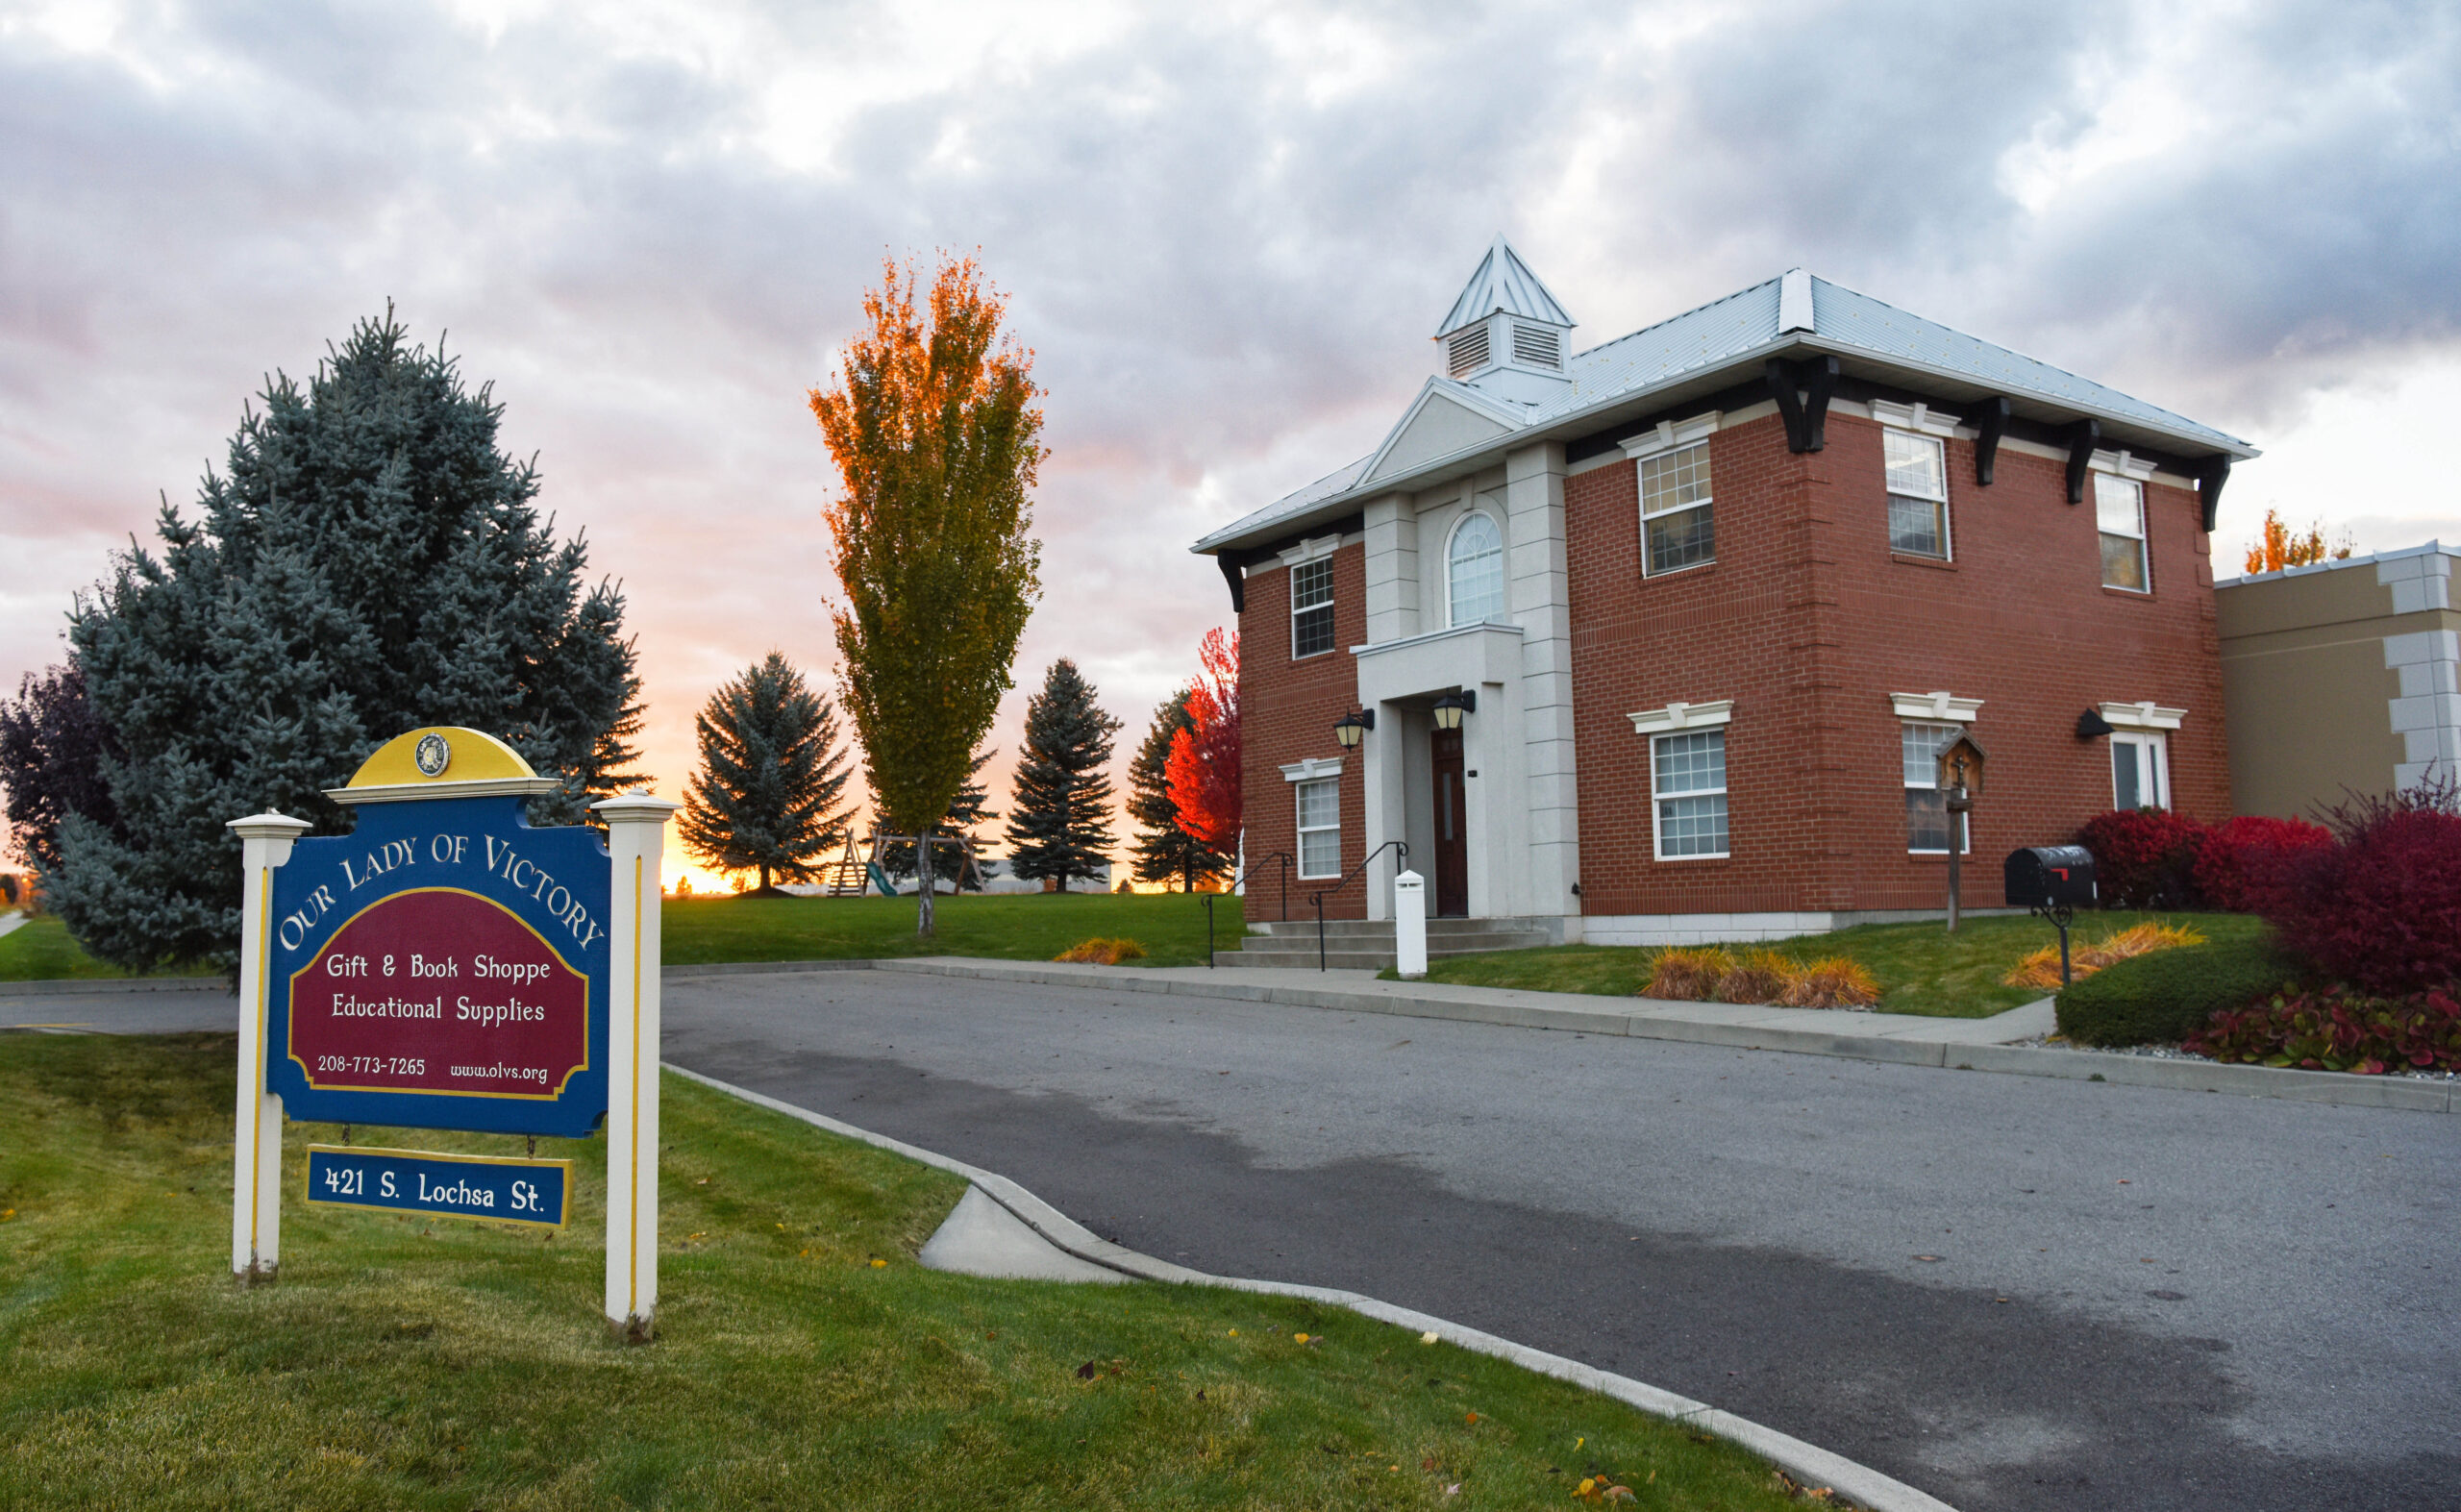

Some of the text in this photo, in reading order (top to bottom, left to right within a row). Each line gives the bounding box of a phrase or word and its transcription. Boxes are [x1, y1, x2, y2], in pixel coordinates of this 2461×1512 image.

[279, 833, 606, 952] OUR LADY OF VICTORY
[327, 954, 551, 985] Gift & Book Shoppe
[332, 993, 545, 1028] Educational Supplies
[317, 1055, 425, 1076] 208-773-7265
[450, 1062, 548, 1084] www.olvs.org
[325, 1167, 545, 1213] 421 S. Lochsa St.
